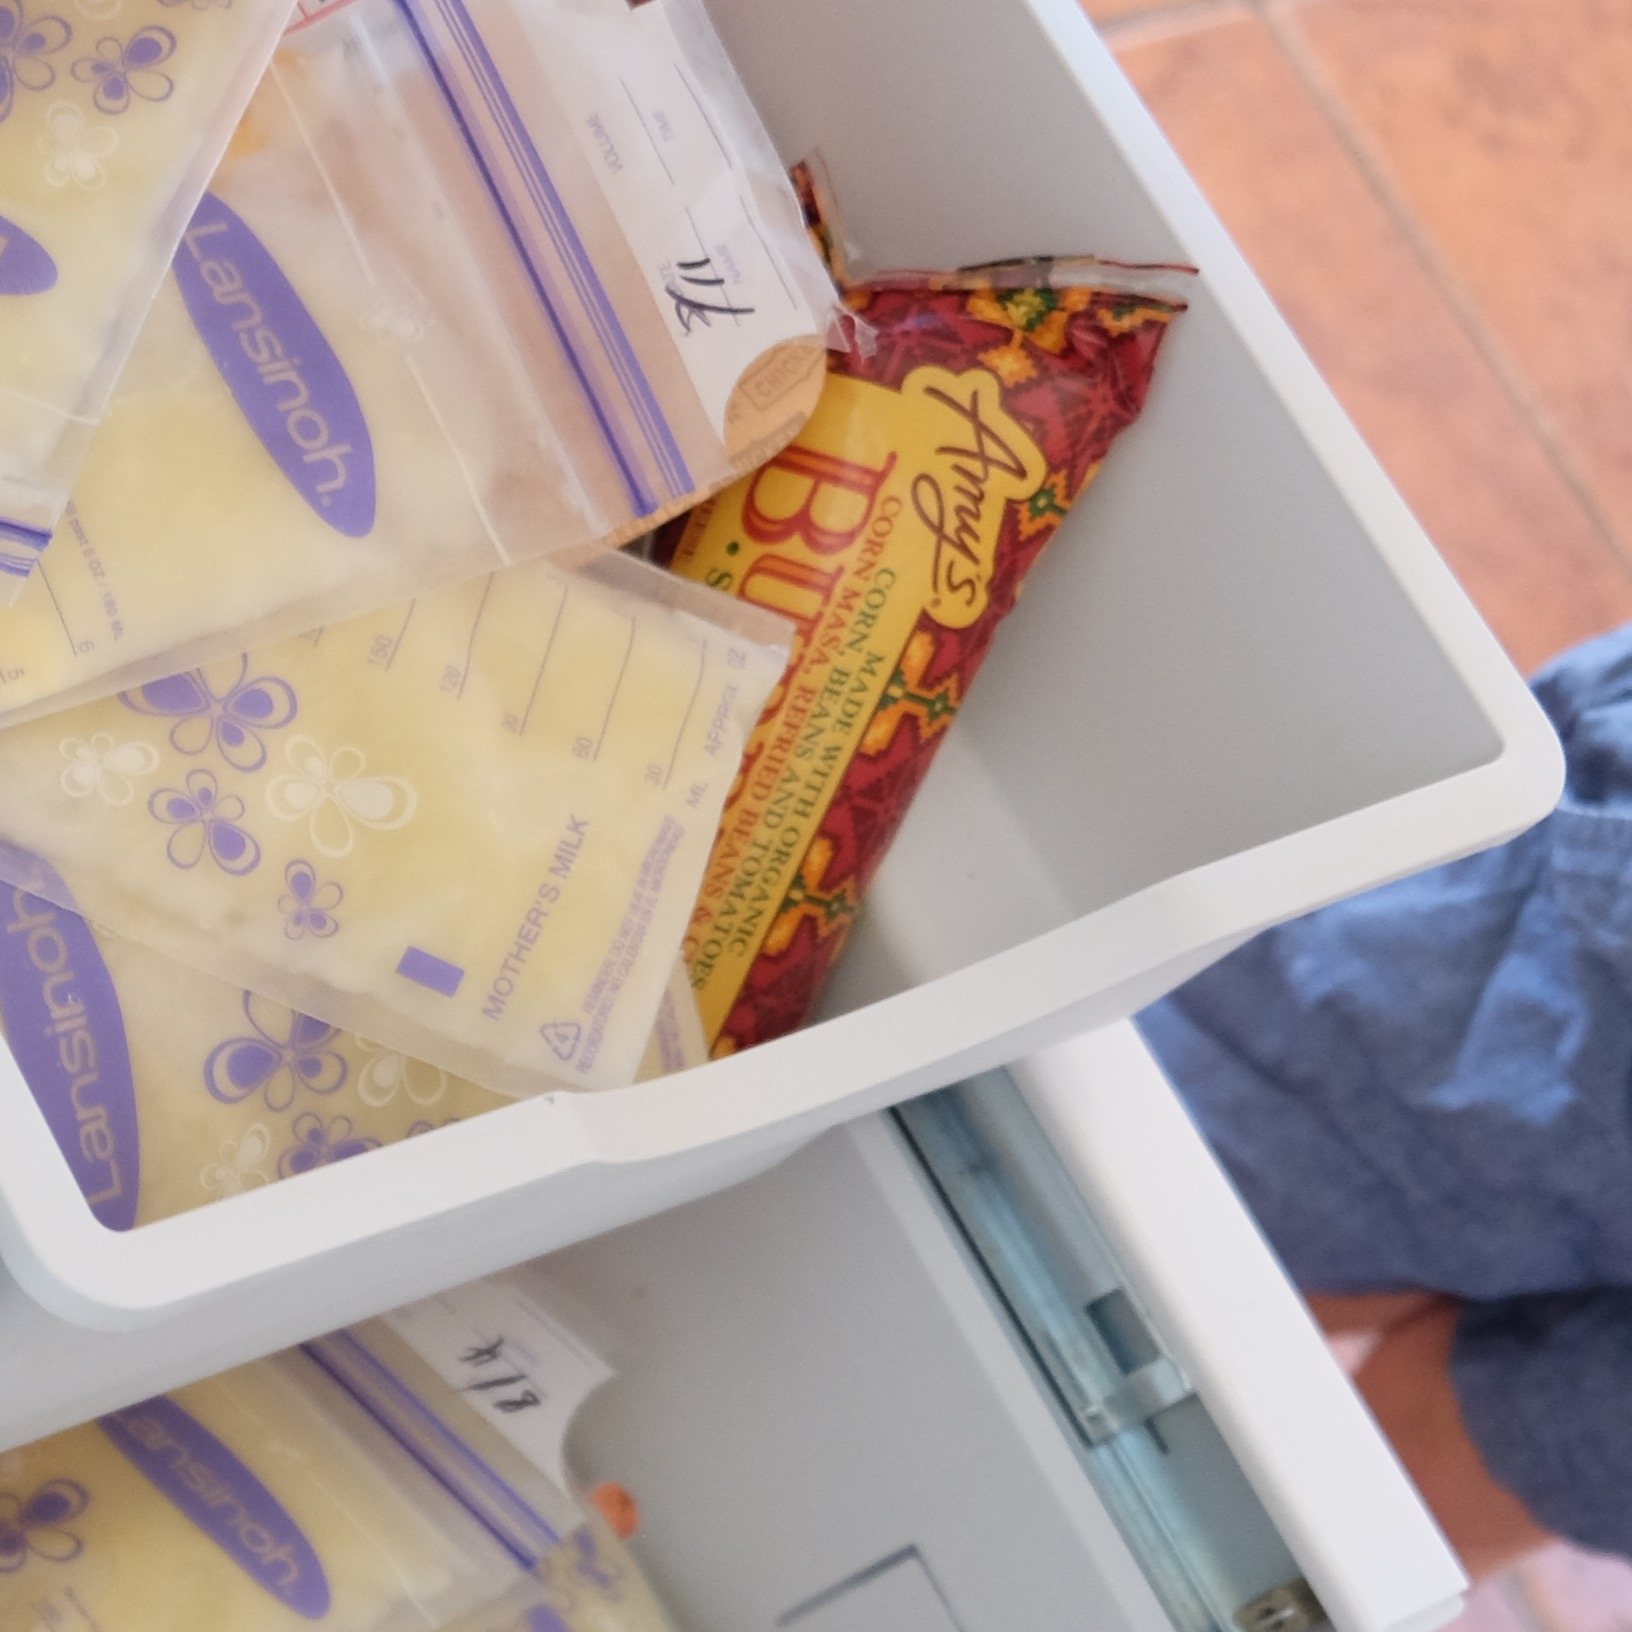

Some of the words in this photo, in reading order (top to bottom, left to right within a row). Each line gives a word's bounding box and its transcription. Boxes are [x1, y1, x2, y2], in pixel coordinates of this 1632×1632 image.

[183, 219, 348, 500] Lansinoh
[853, 495, 902, 582] CORN
[909, 382, 1030, 612] Amy's
[805, 590, 855, 673] MASA,
[837, 567, 896, 661] CORN,
[750, 685, 817, 809] REFRIED
[794, 665, 850, 762] BEANS
[849, 653, 886, 734] MADE
[766, 766, 802, 832] AND
[796, 740, 845, 823] WITH
[701, 805, 760, 898] BEANS
[729, 825, 802, 961] ORGANIC
[481, 883, 562, 1022] MOTHER'S
[547, 813, 590, 880] MILK
[691, 839, 776, 990] TOMATOES
[5, 881, 130, 1206] Lansinoh
[114, 1405, 304, 1592] ansinoh
